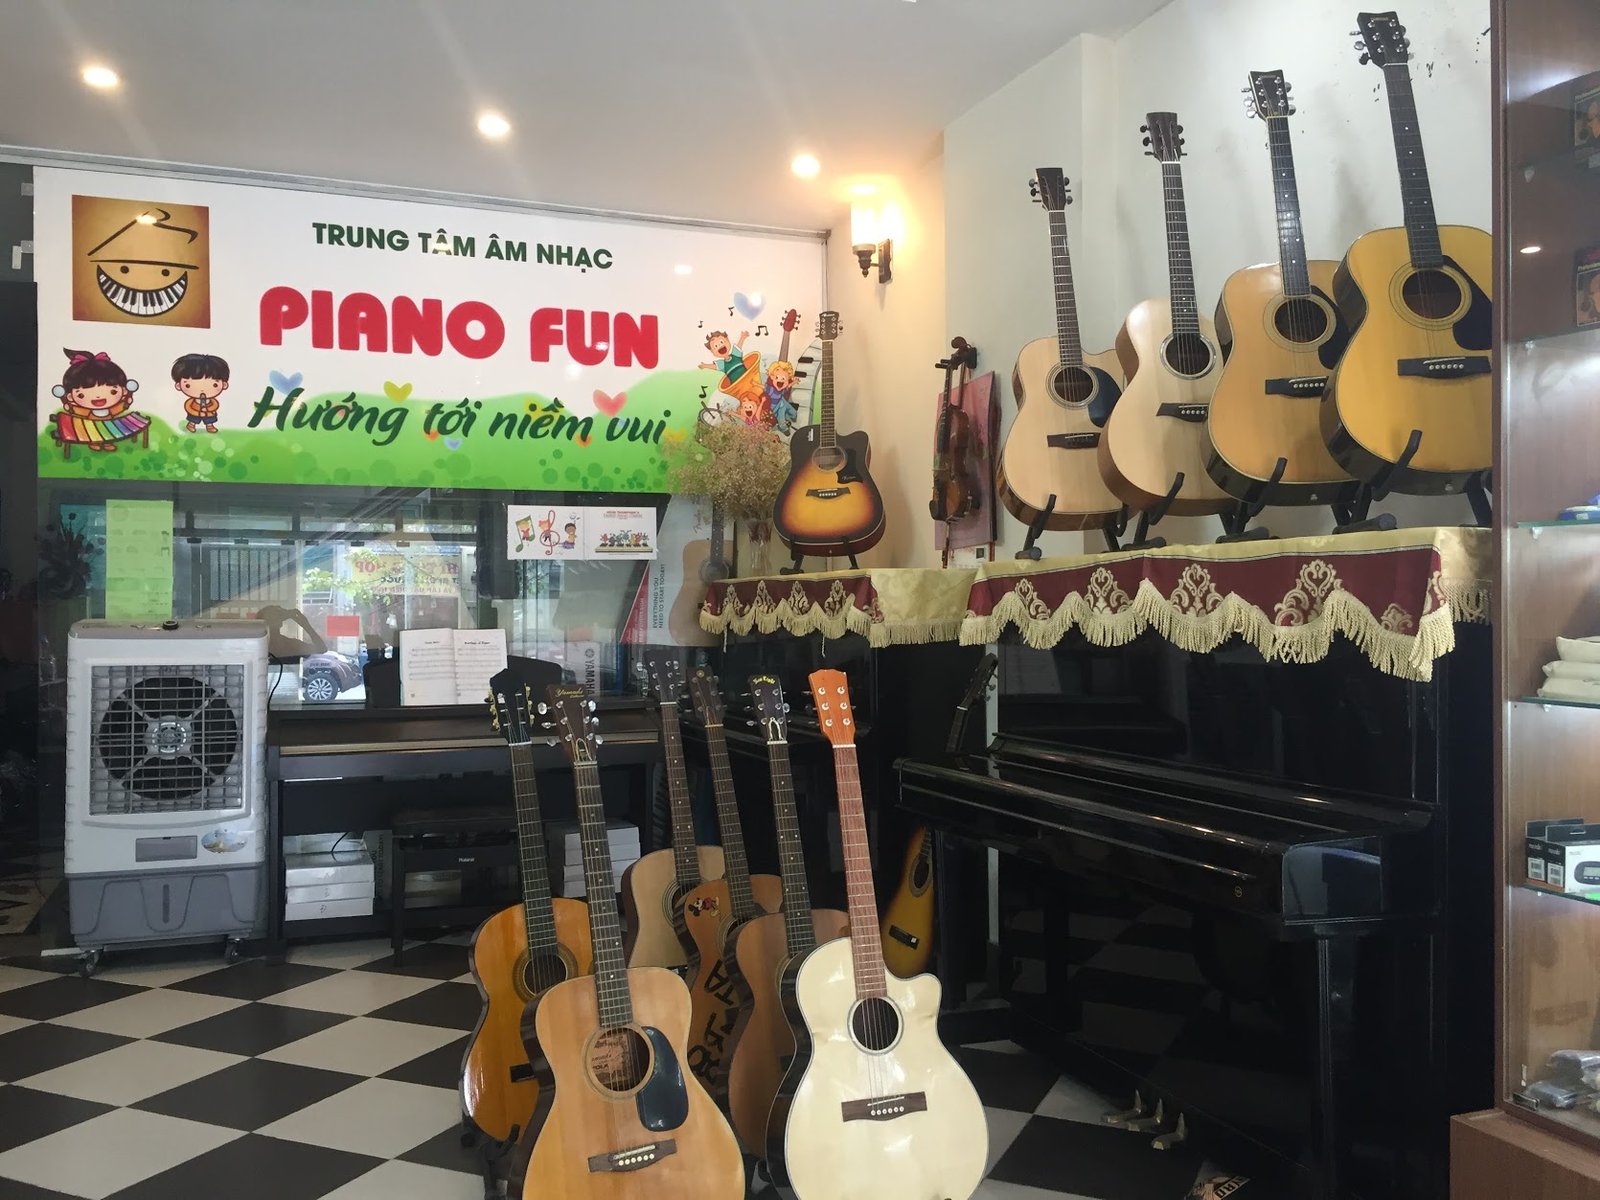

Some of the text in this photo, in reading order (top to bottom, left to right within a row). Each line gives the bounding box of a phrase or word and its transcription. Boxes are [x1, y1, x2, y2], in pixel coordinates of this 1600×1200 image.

[312, 222, 613, 273] TRUNG TÂM ÂM NHẠC
[259, 285, 659, 369] PIANO FUN
[247, 386, 670, 446] Hướng tới niềm vui
[659, 604, 665, 612] TO
[585, 659, 595, 695] YAMAHA
